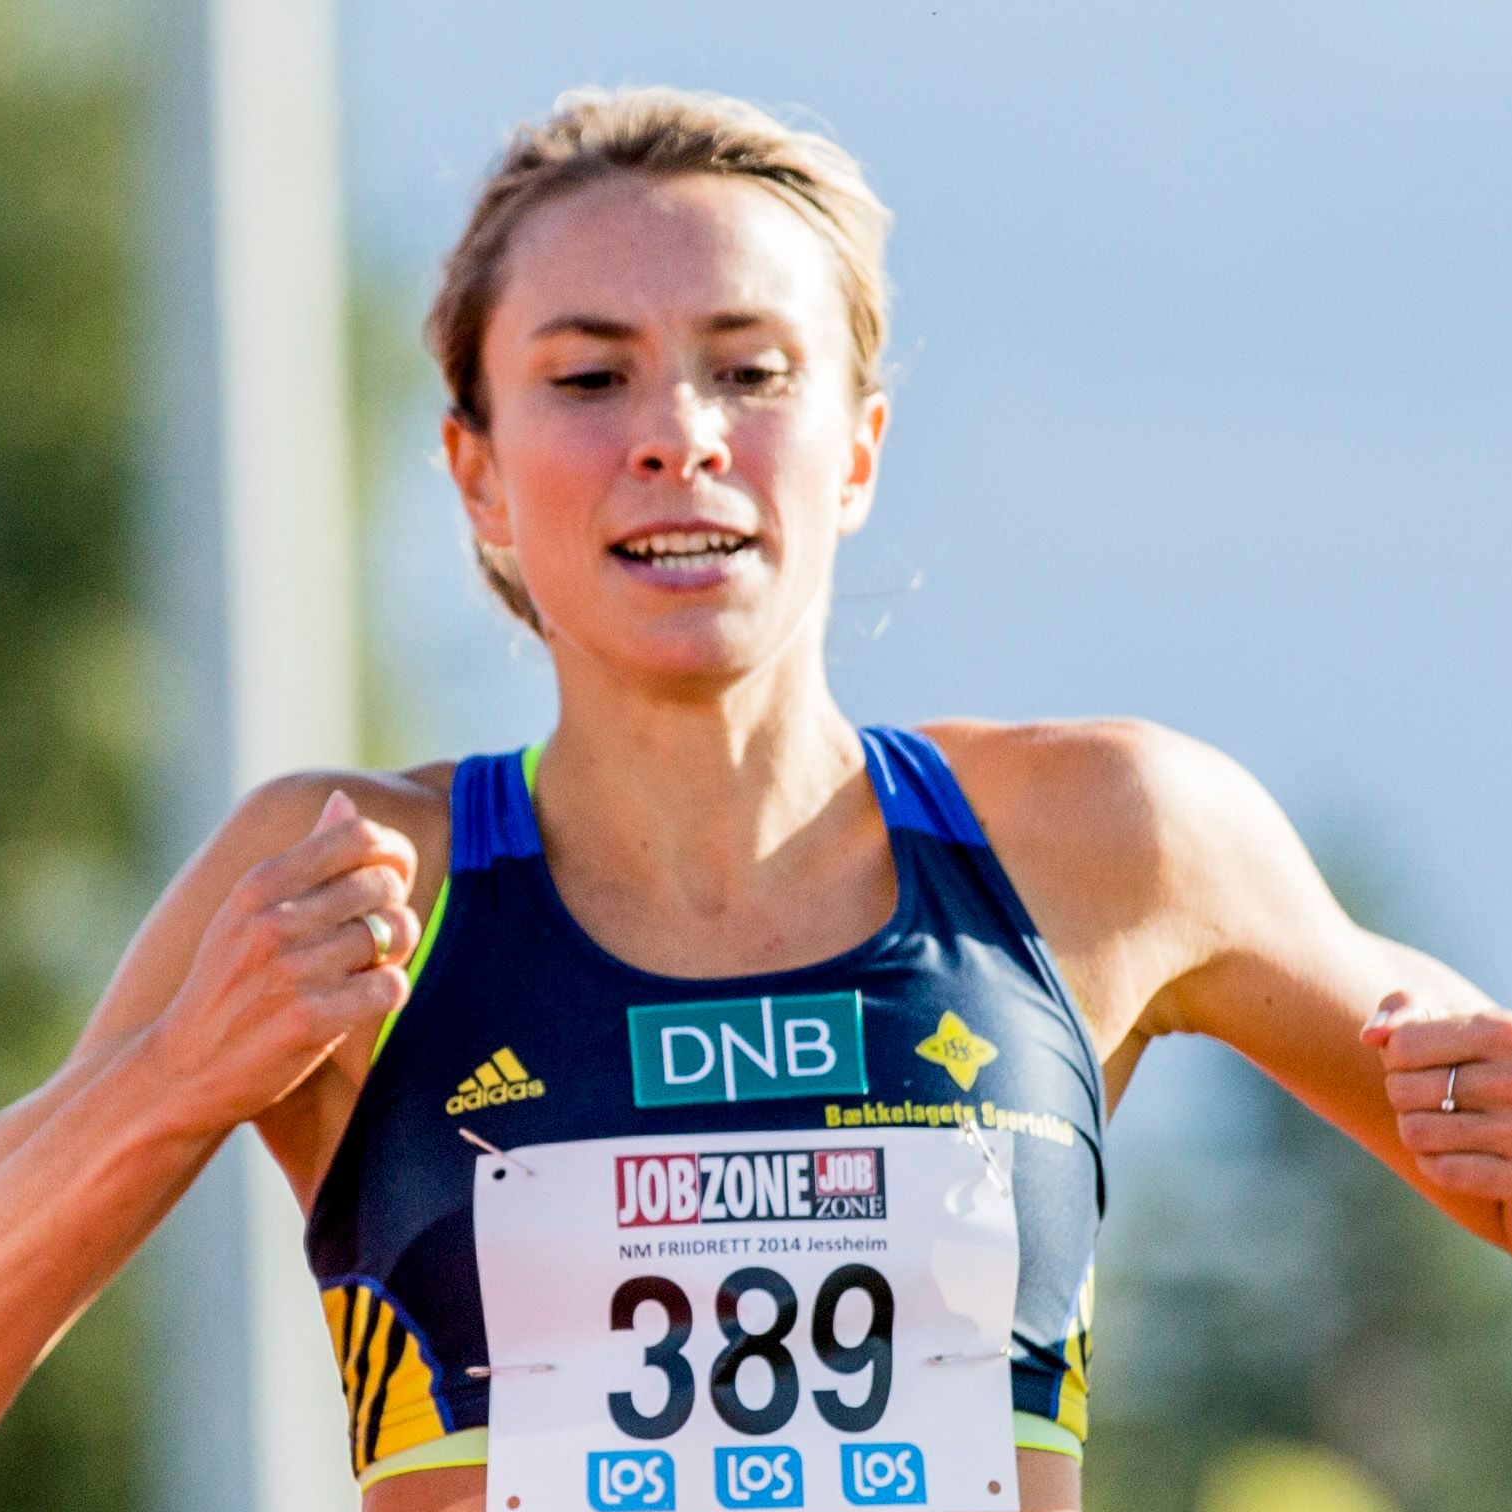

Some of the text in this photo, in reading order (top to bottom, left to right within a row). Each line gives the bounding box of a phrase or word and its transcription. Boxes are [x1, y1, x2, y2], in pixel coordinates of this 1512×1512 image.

[660, 995, 837, 1101] DNB
[445, 1079, 546, 1116] adidas
[817, 1152, 874, 1192] JOB
[815, 1196, 885, 1219] ZONE
[619, 1235, 888, 1260] NM FRIIDRETT 2014 Jessheim
[606, 1262, 896, 1441] 389
[598, 1449, 917, 1505] LOS LOS LOS
